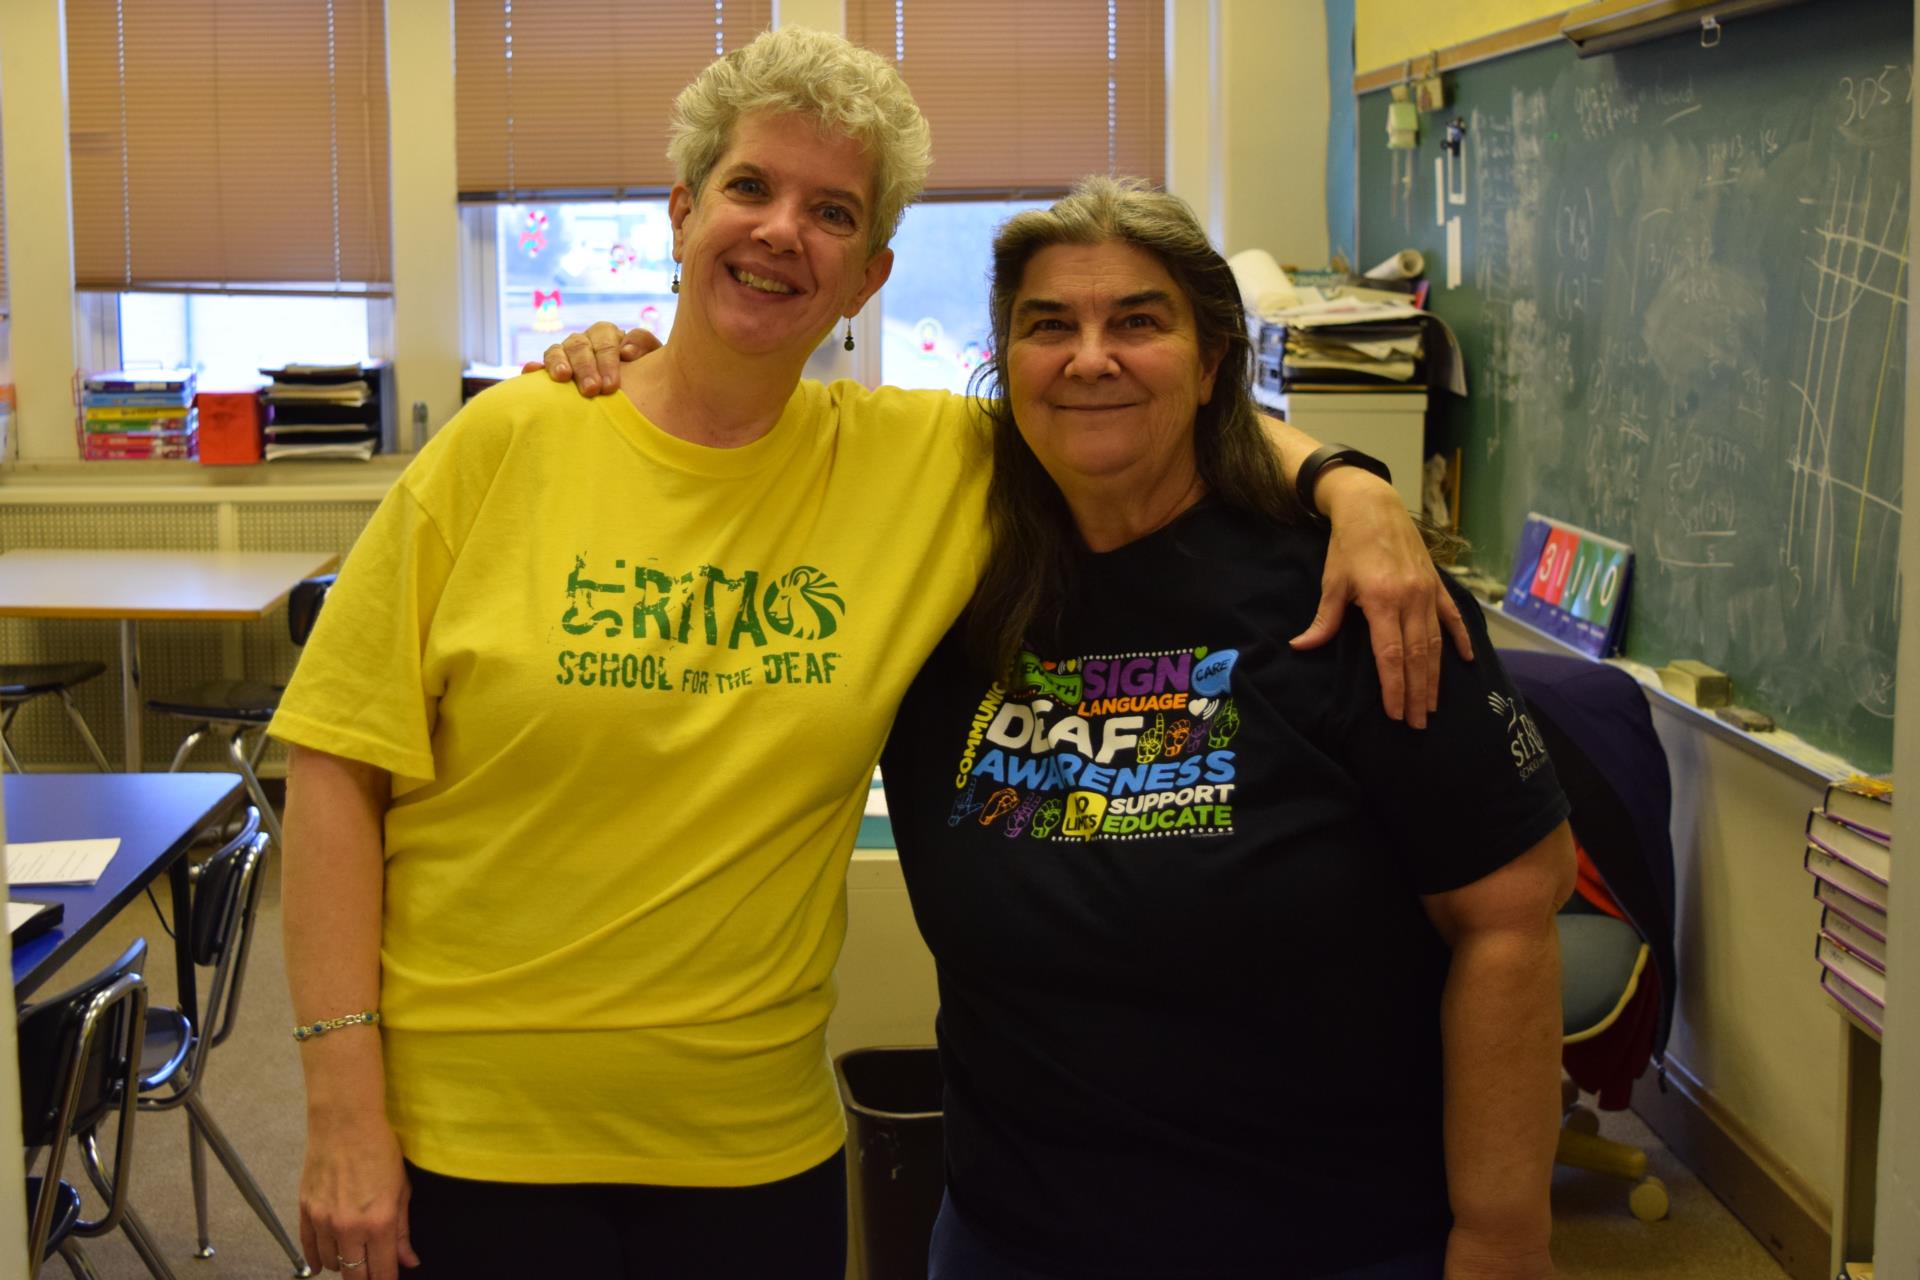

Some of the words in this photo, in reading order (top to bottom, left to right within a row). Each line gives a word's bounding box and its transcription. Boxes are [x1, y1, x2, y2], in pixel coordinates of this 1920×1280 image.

[556, 650, 673, 690] SCHOOL
[681, 668, 709, 694] FOR
[715, 667, 753, 694] THE
[762, 651, 840, 684] DEAF
[1083, 653, 1192, 700] SIGN
[1196, 658, 1230, 682] CARE
[1077, 693, 1188, 718] LANGUAGE
[986, 699, 1144, 764] DEAF
[971, 748, 1236, 796] AWARENESS
[1108, 783, 1236, 815] SUPPORT
[1101, 804, 1233, 834] EDUCATE
